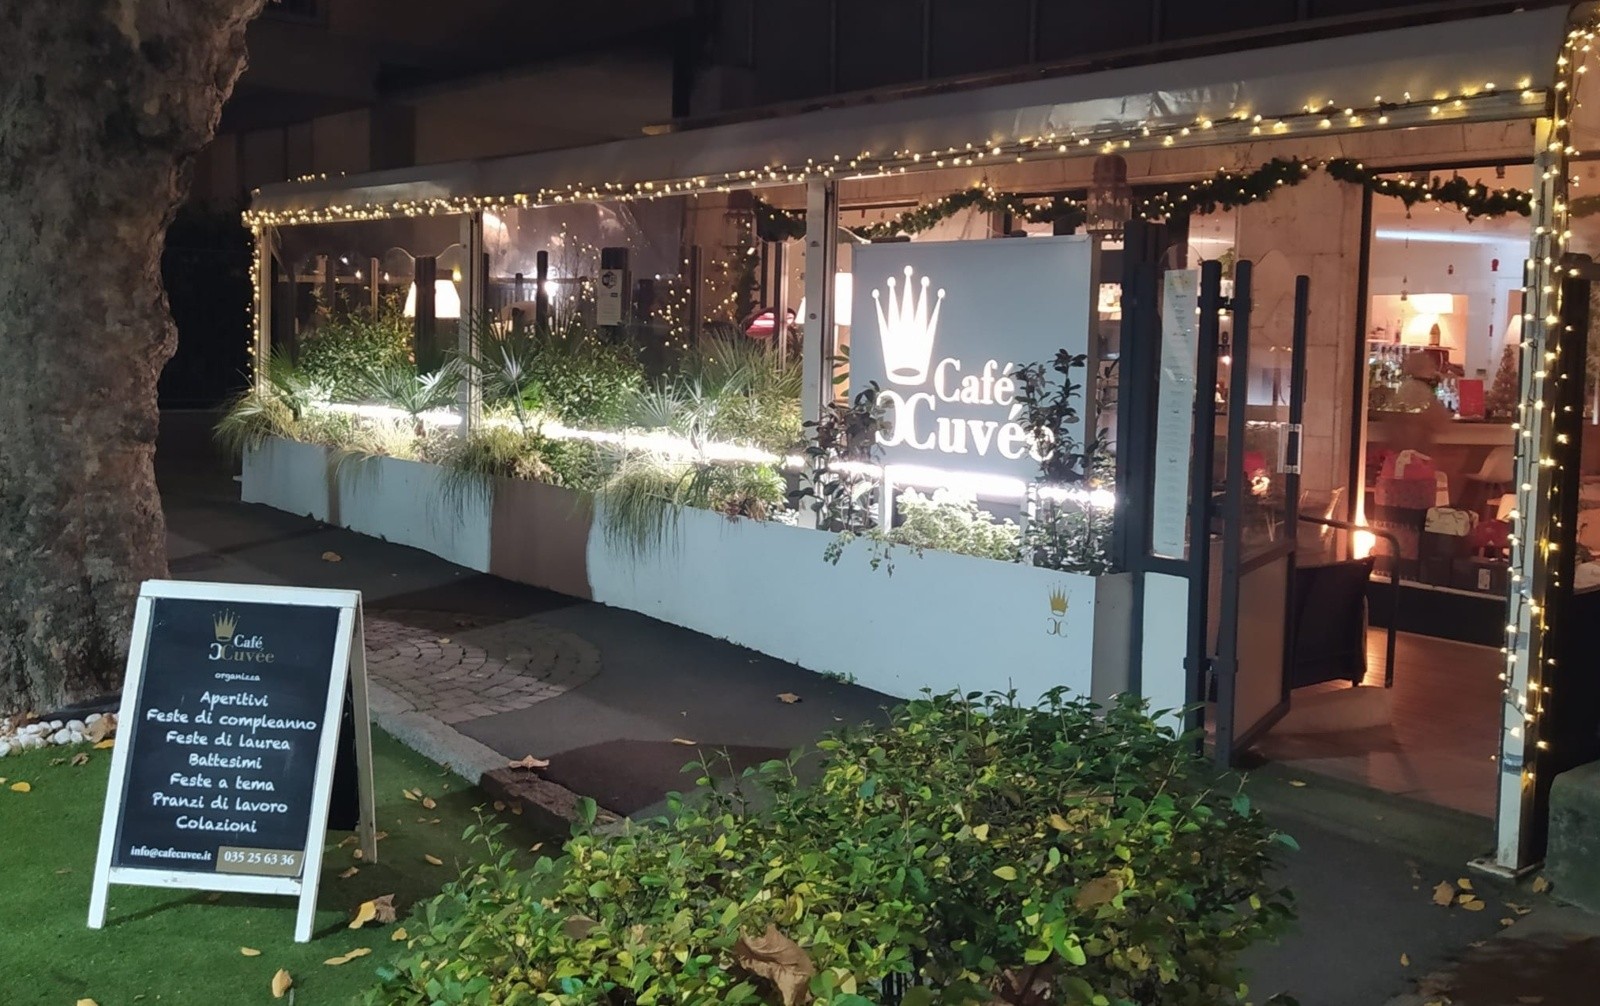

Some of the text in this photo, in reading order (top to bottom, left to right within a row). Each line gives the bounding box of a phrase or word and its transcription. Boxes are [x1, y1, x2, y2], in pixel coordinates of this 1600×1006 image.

[934, 358, 1015, 405] Café
[233, 634, 263, 649] Café
[214, 672, 261, 682] organizza
[200, 691, 269, 711] Aperitivi
[146, 709, 317, 734] Feste di compleanno
[166, 730, 291, 750] Feste di laurea
[188, 752, 262, 769] Battesimi
[169, 772, 275, 791] Feste a tema
[152, 792, 288, 813] Pranzi di lavoro
[176, 815, 257, 833] Colazioni
[130, 845, 295, 866] info@cafecuvee.it 035 25 63 36
